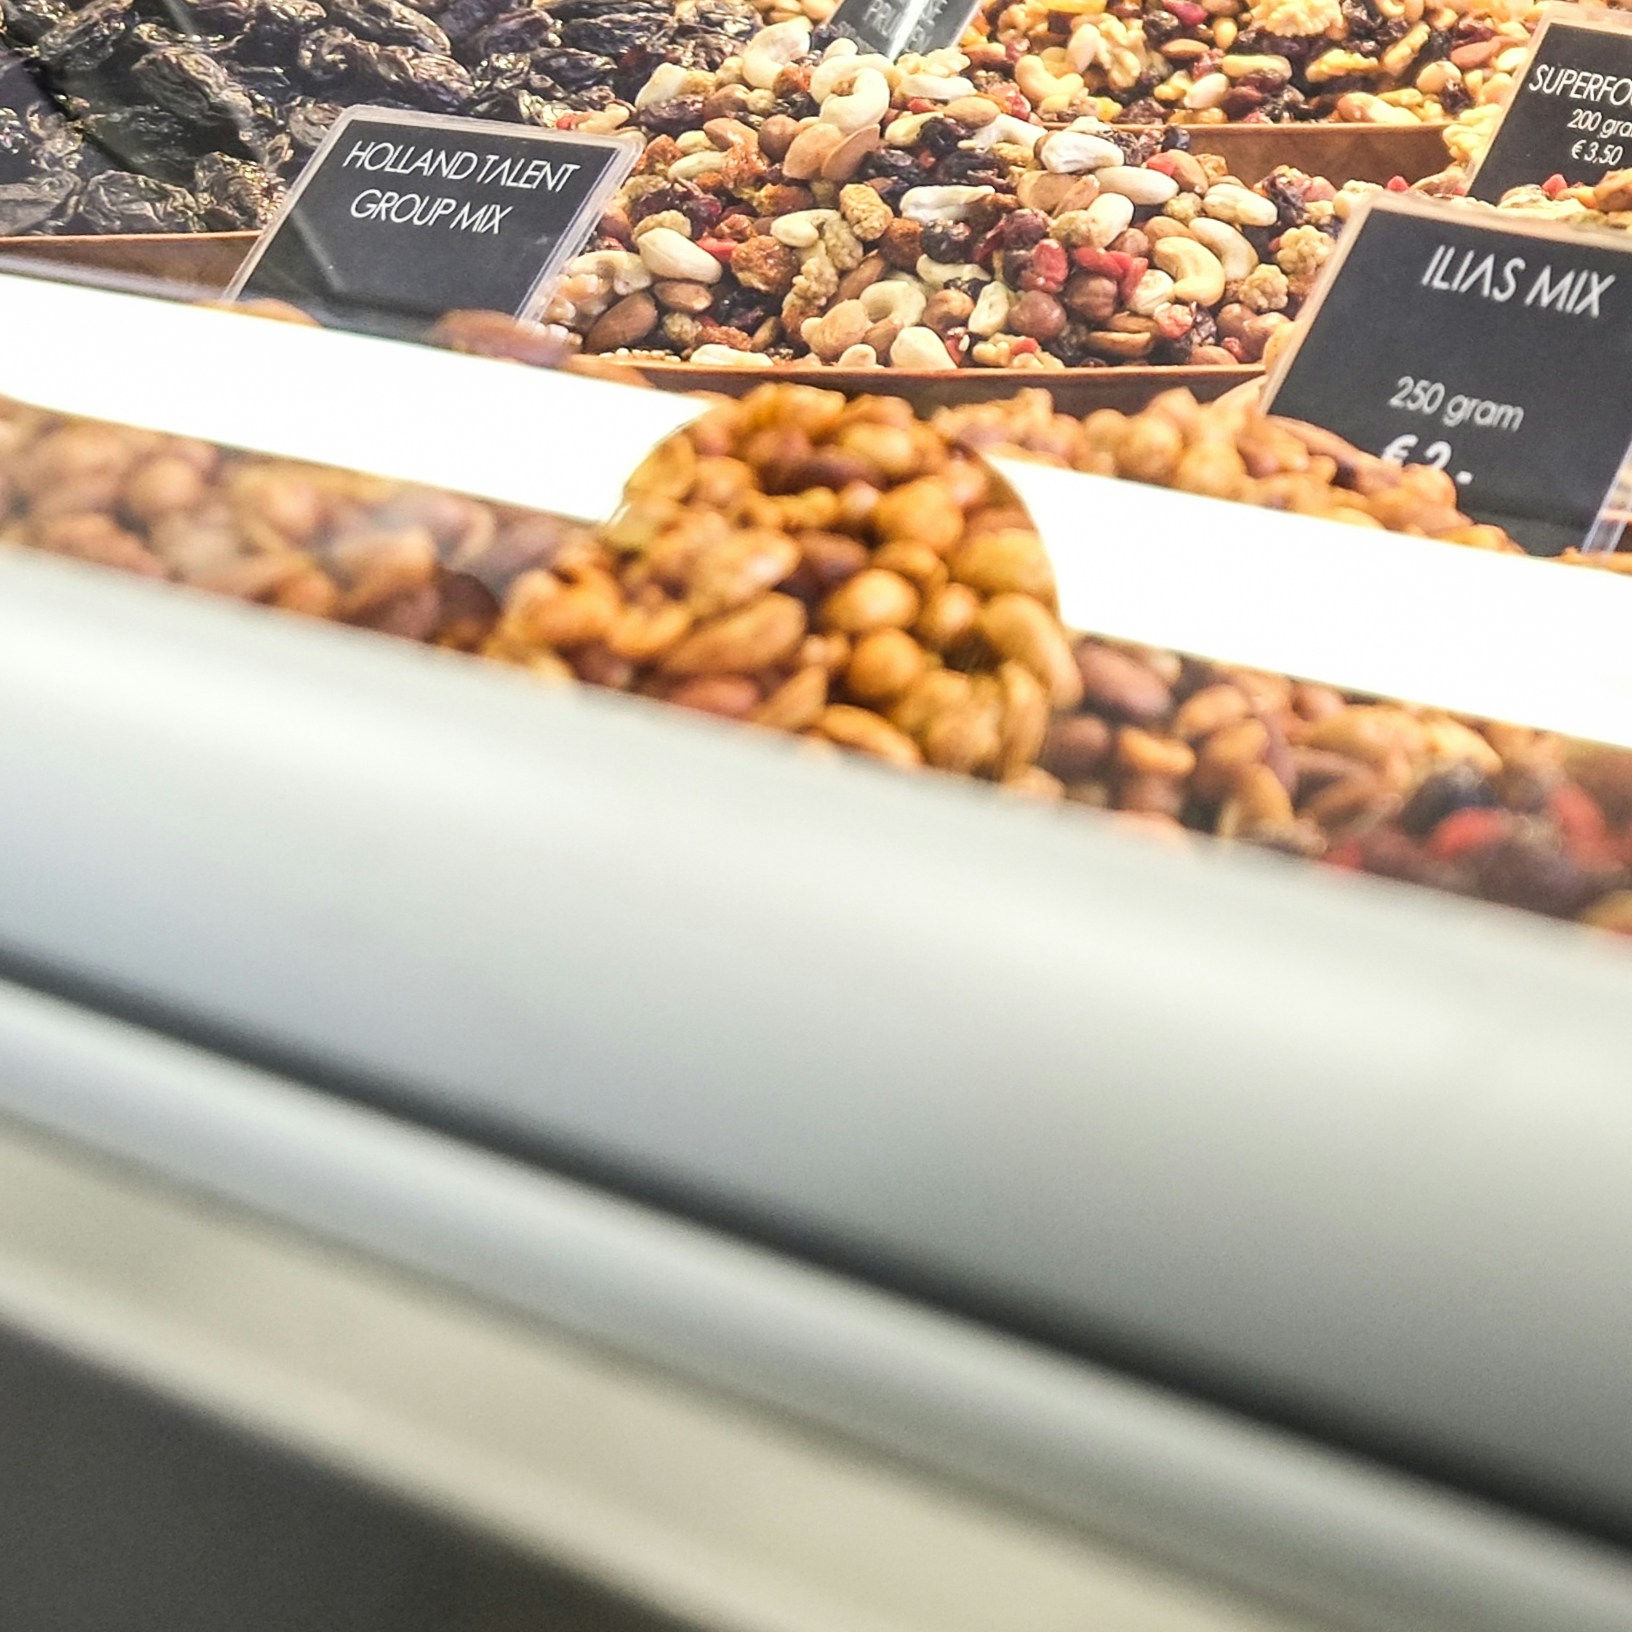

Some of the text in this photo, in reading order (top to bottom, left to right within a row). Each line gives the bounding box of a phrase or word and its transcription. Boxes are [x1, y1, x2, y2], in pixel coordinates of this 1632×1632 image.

[1566, 109, 1602, 132] 200
[342, 140, 582, 193] HOLLAND TALENT
[1570, 139, 1624, 166] € 3,50
[350, 188, 514, 235] GROUP MIX
[1420, 244, 1617, 319] ILIAS MIX
[1387, 375, 1526, 433] 250 gram
